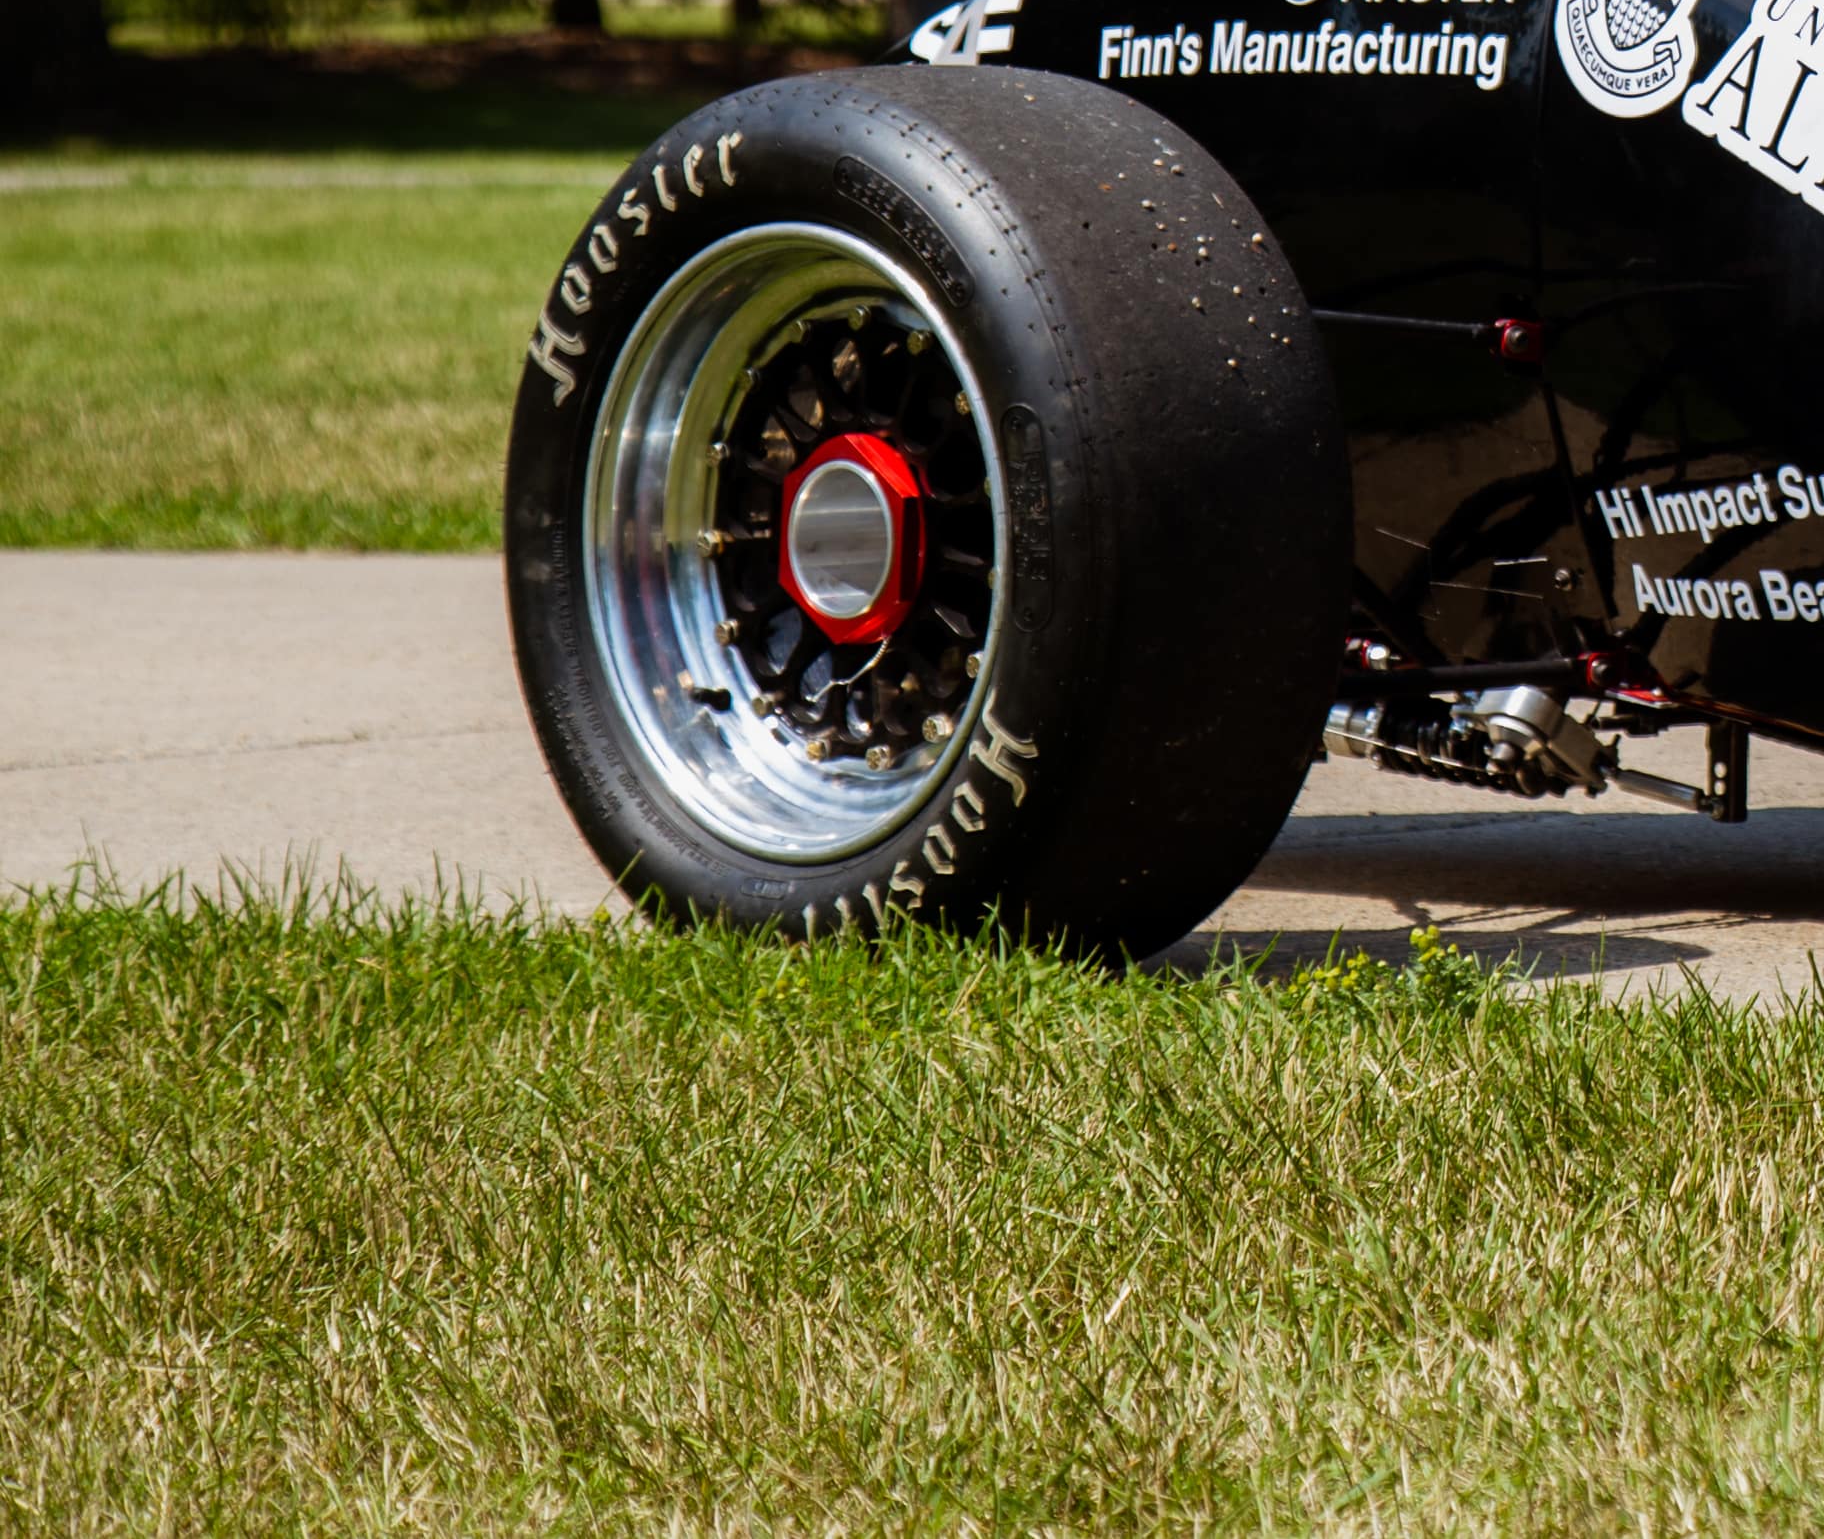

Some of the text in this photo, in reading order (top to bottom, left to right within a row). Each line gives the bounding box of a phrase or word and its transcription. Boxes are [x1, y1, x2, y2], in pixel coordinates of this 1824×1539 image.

[1100, 19, 1507, 91] Finn's Manufacturing
[1571, 7, 1669, 90] QUAECUMQUE VERA
[529, 131, 743, 408] Hoosier
[1597, 486, 1643, 538] Hi
[1645, 474, 1778, 543] Impact
[1632, 565, 1759, 622] Aurora
